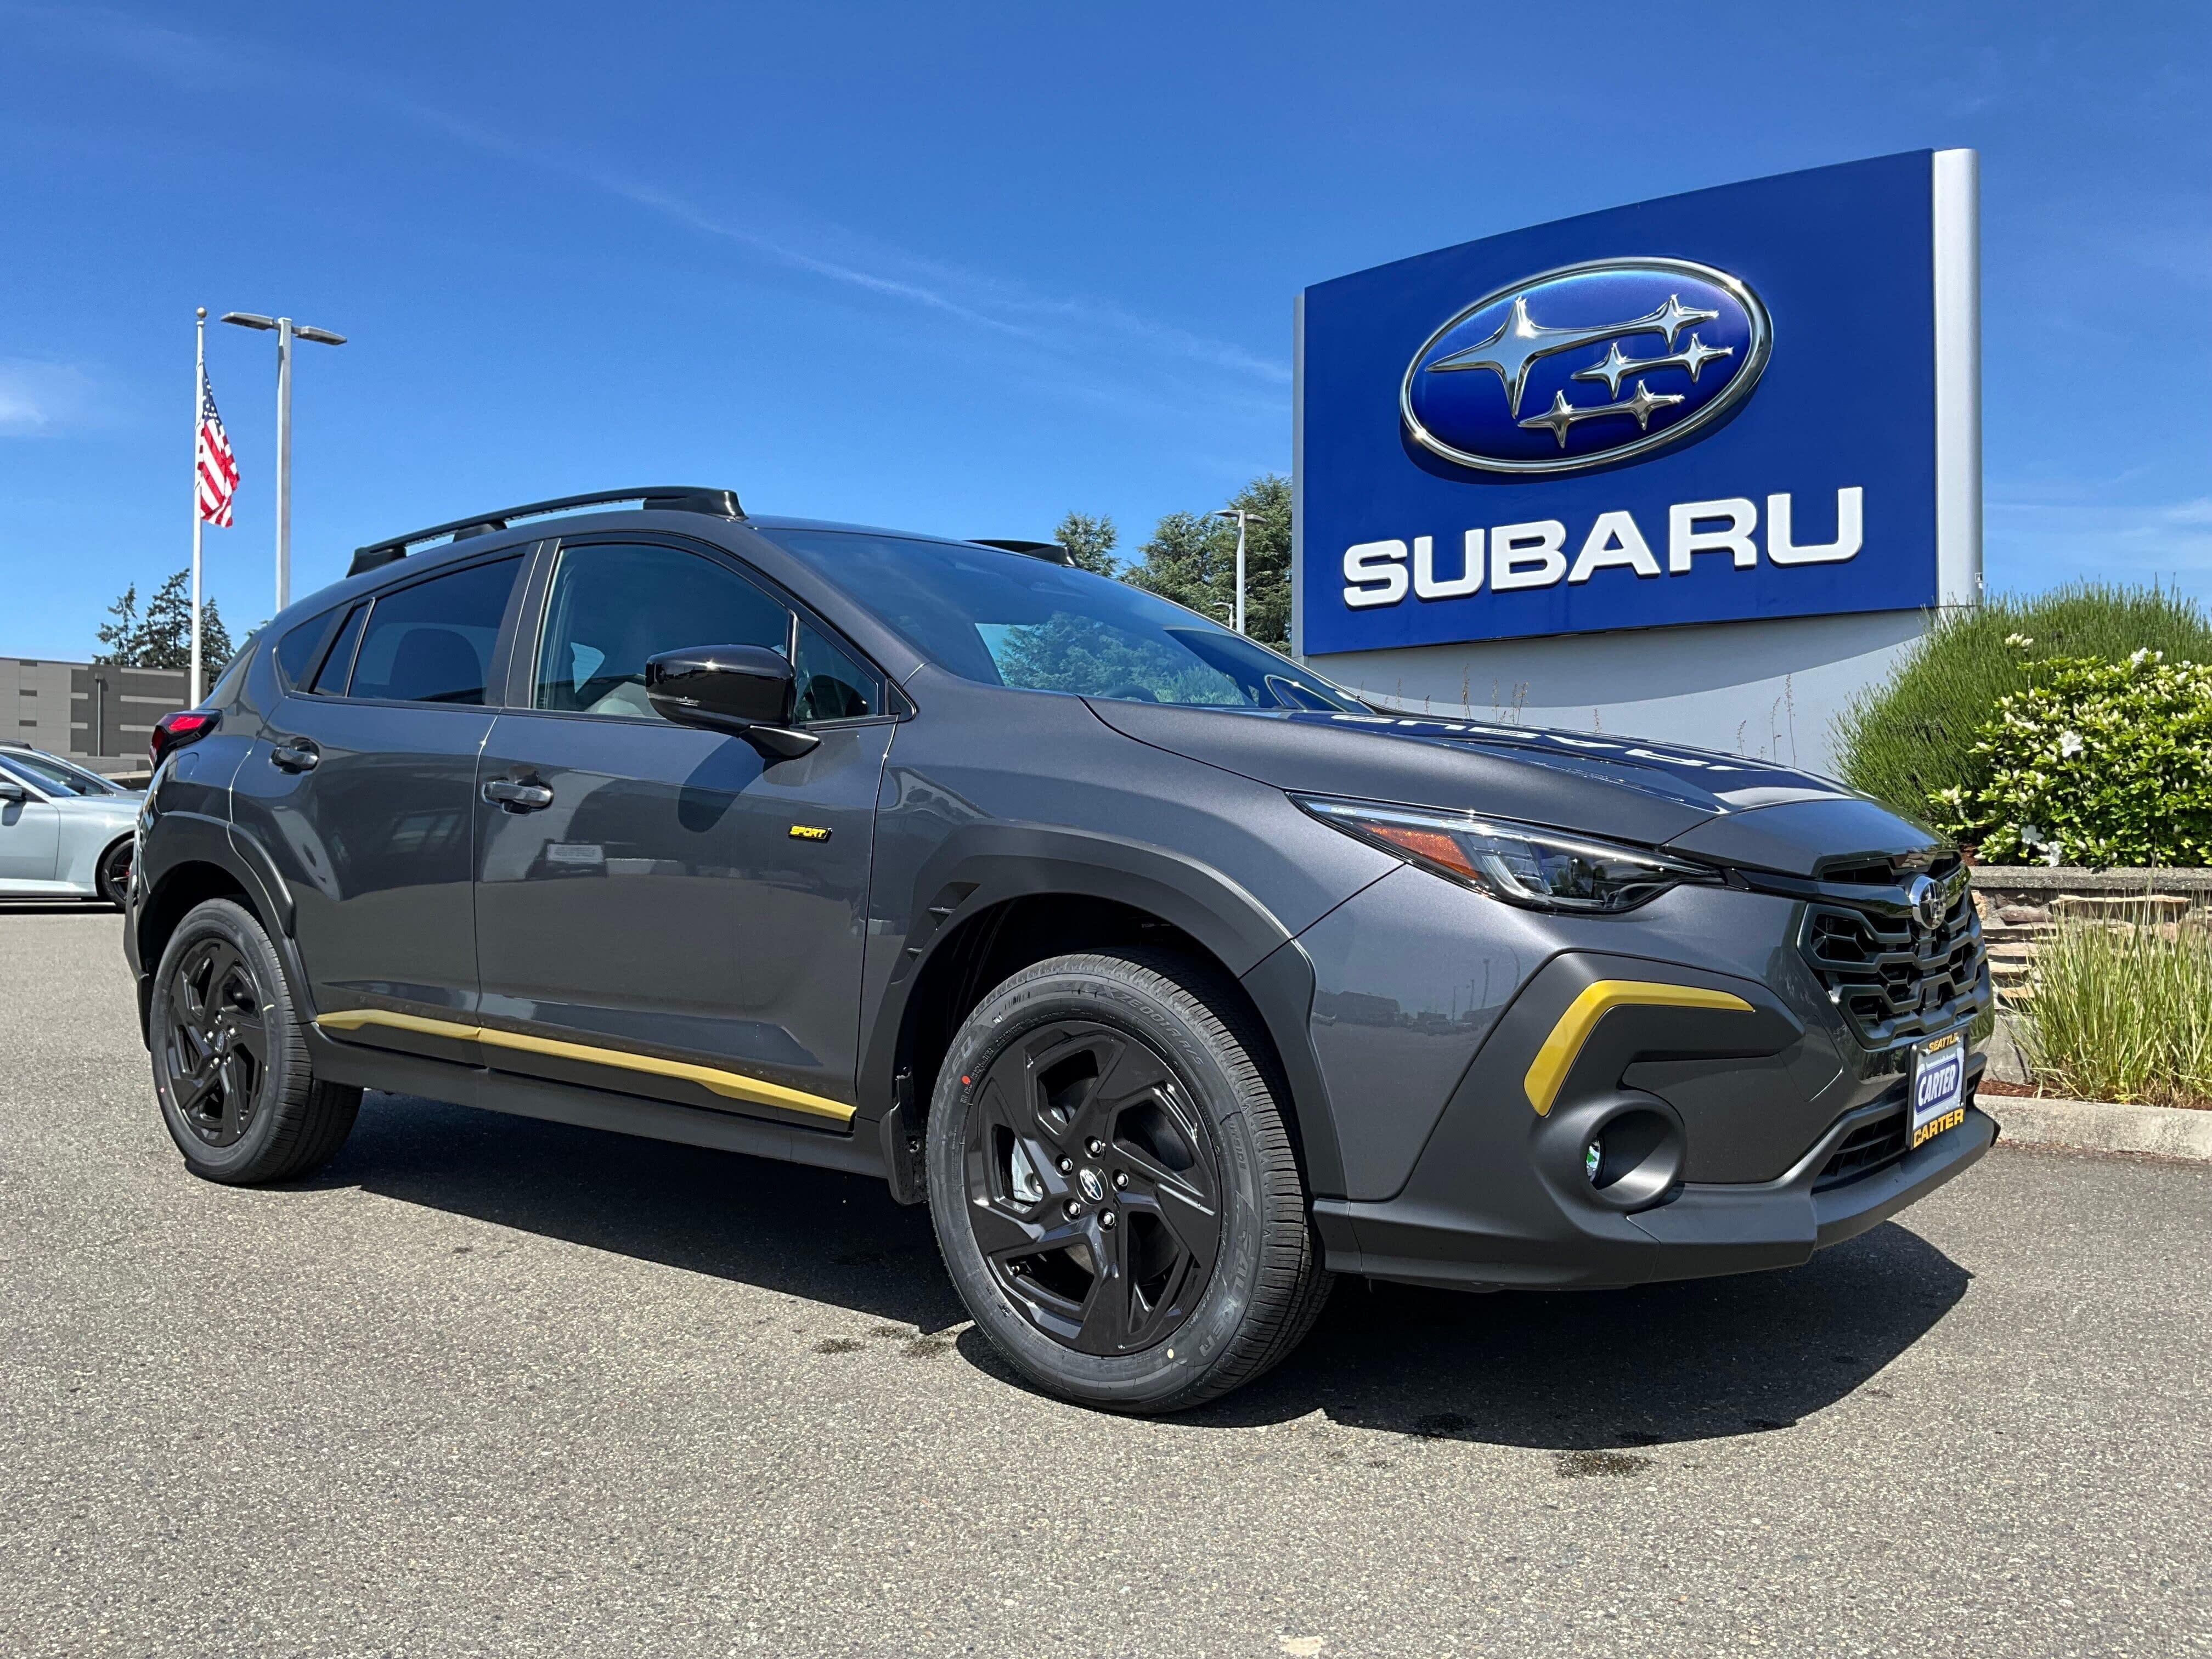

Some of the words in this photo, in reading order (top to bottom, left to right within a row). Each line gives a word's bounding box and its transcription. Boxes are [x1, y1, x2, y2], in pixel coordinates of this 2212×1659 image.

[1343, 486, 1863, 608] SUBARU
[790, 826, 826, 838] SPORT
[1928, 1032, 1959, 1053] SEATTLE
[1918, 1064, 1956, 1107] CARTER
[1912, 1108, 1964, 1148] CARTER
